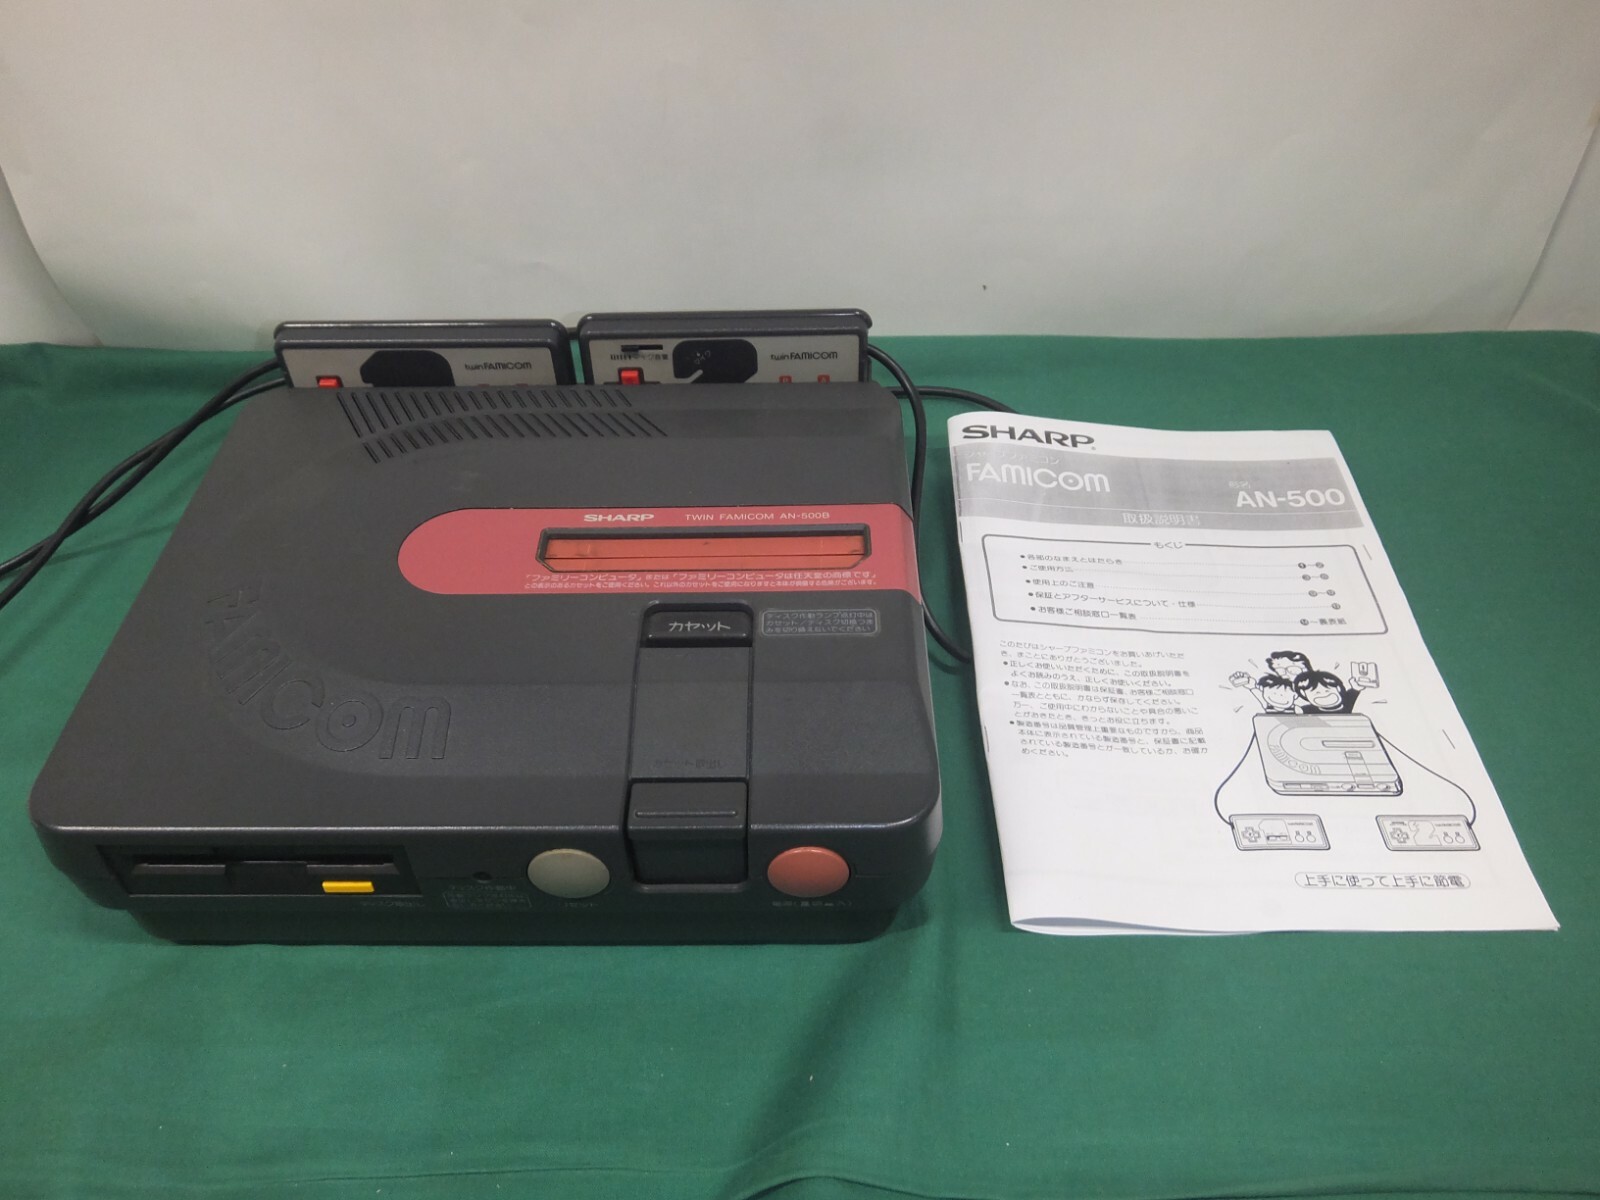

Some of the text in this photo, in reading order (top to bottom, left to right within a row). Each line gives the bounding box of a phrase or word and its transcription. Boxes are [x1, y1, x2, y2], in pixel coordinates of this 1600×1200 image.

[962, 424, 1095, 449] SHARP
[966, 462, 1112, 493] FAMICOM
[1236, 488, 1346, 508] AN-500
[583, 512, 655, 523] SHARP
[685, 511, 831, 521] TWIN FAMICOM AN-500B
[1153, 540, 1184, 549] もくじ
[1027, 553, 1123, 565] 各部のなまえとはたらき
[1032, 578, 1095, 589] 使用上のご注意
[1038, 606, 1137, 620] お客様ご相談窓口一覧表
[668, 621, 731, 632] カセット
[1304, 873, 1465, 888] 上手に使って上手に節電
